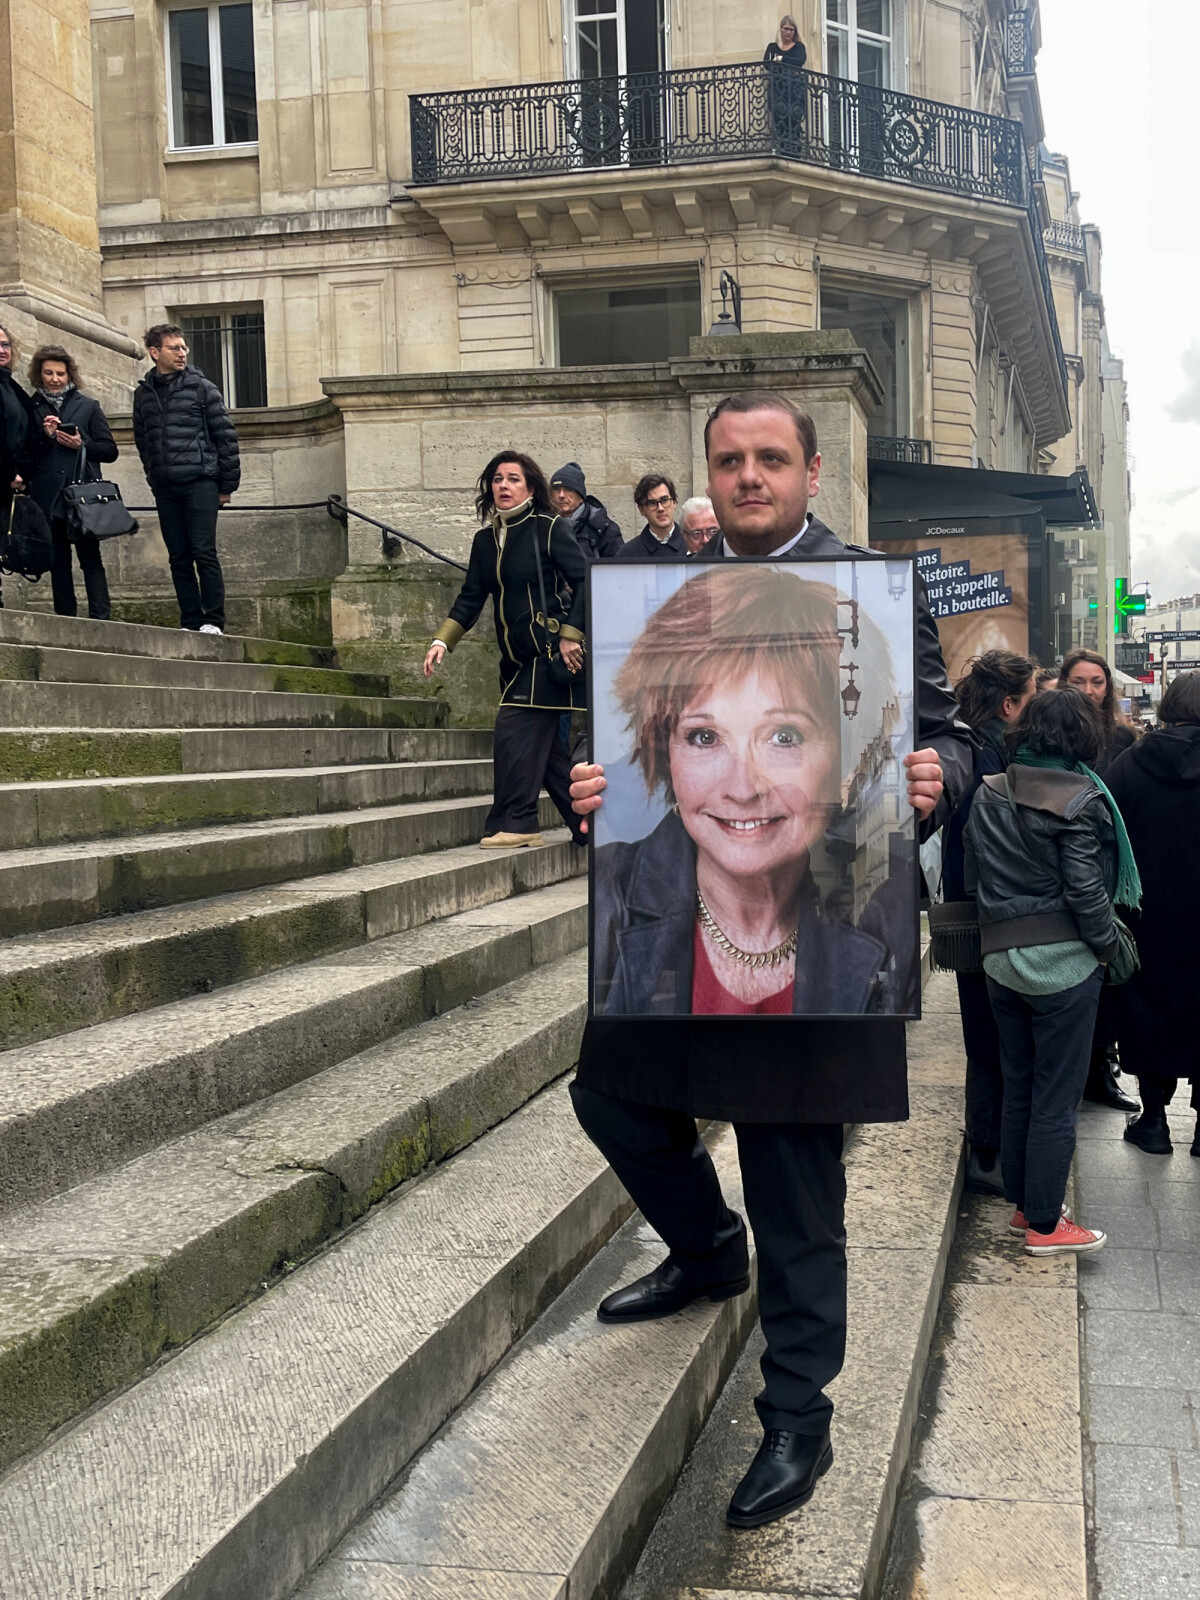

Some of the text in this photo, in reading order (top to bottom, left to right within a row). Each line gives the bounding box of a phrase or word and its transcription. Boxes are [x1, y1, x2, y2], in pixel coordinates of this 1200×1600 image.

[925, 527, 965, 535] JCDecaux
[945, 573, 999, 597] s'appelle
[938, 601, 949, 615] la
[951, 591, 1009, 613] bouteille.
